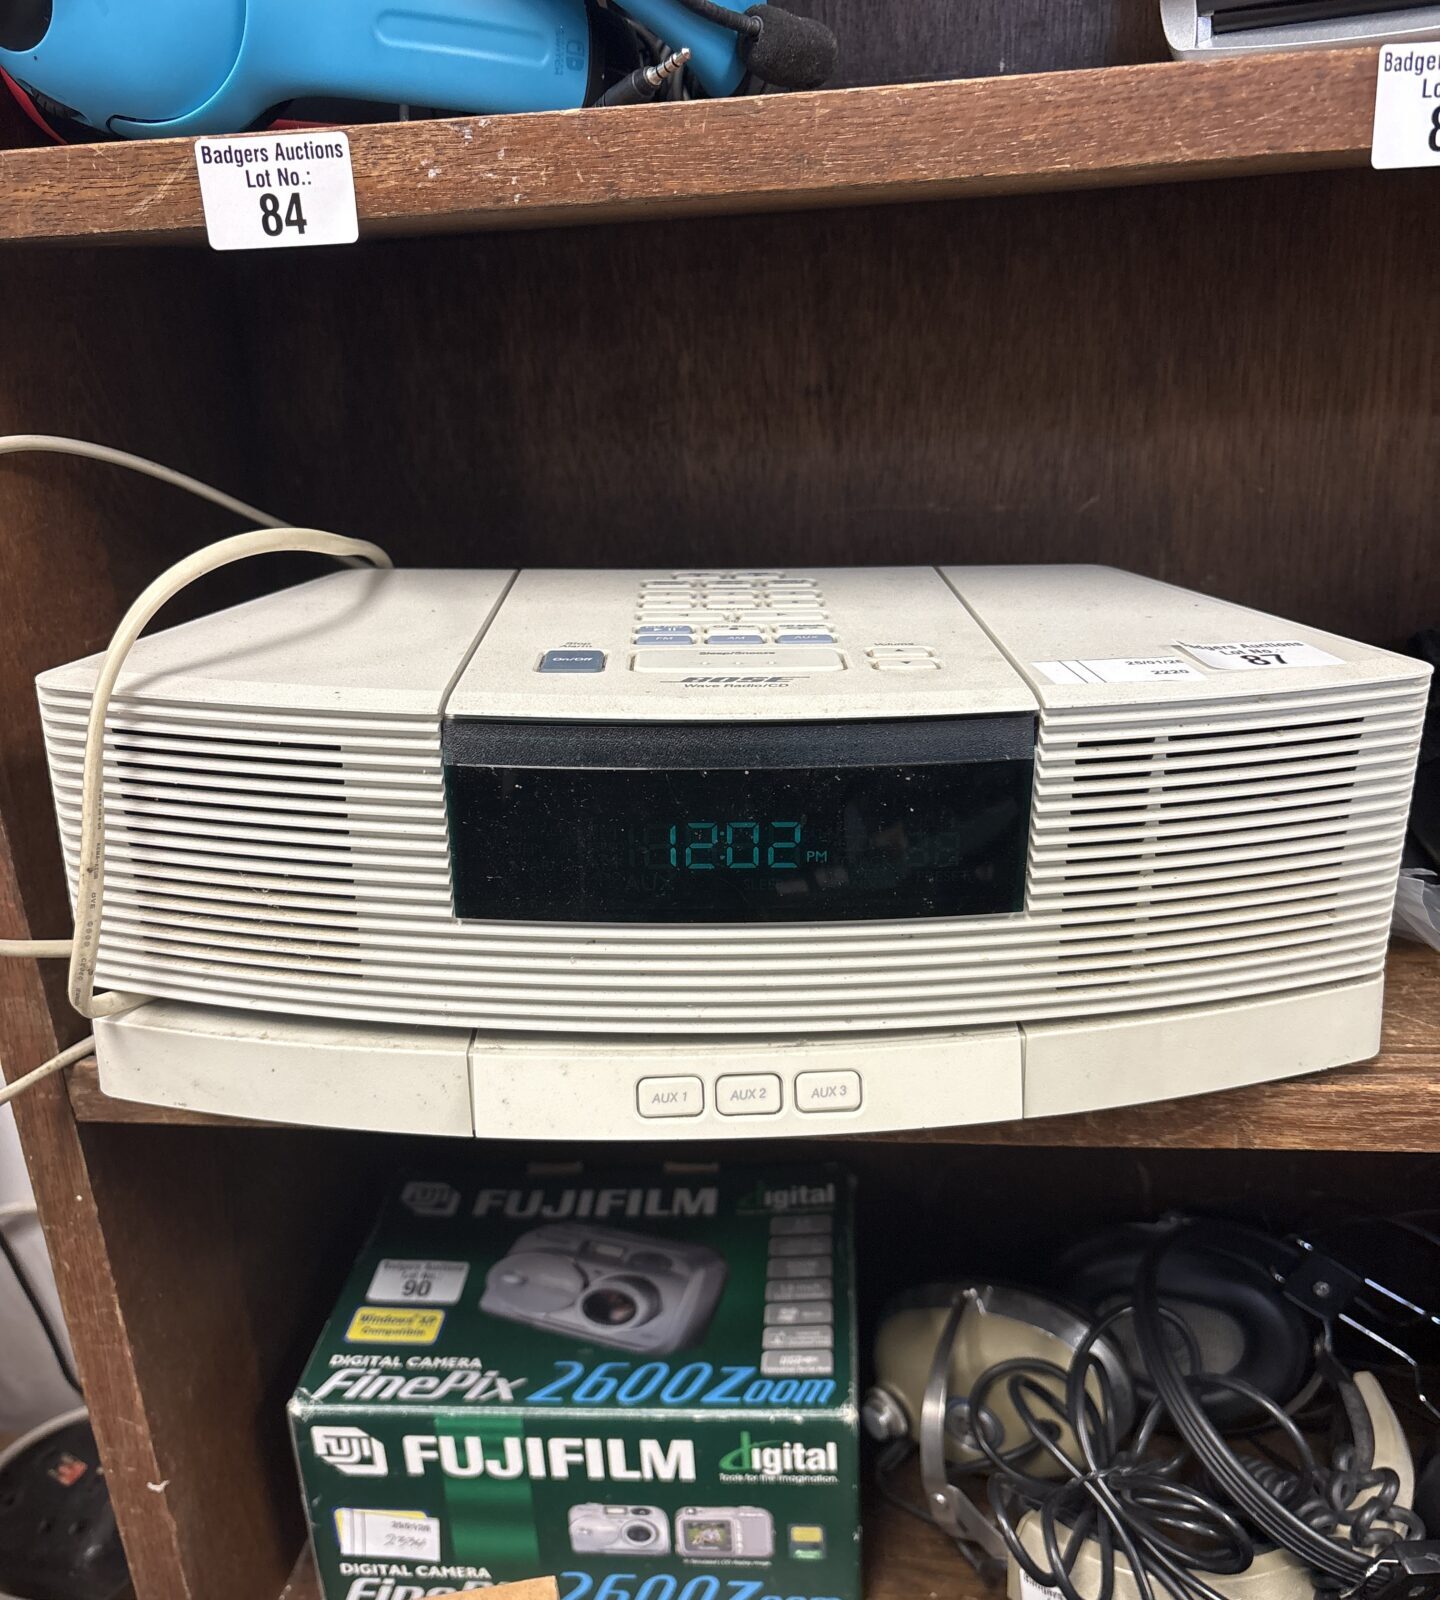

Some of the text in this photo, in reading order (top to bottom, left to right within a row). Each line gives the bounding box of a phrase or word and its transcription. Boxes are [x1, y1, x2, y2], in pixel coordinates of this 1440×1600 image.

[1384, 51, 1440, 76] Badge
[201, 141, 343, 167] Badgers Auctions
[245, 167, 312, 188] Lot No.:
[259, 192, 307, 237] 84
[1240, 653, 1289, 666] 87
[669, 821, 828, 869] 12:02 PM
[651, 1092, 688, 1104] AUX 1
[730, 1088, 767, 1101] AUX 2
[811, 1085, 847, 1099] AUX 3
[471, 1187, 719, 1218] FUJIFILM
[402, 1280, 432, 1297] 90
[329, 1354, 482, 1370] DIGITAL CAMERA
[311, 1367, 528, 1402] FinePix
[402, 1434, 697, 1482] FUJIFILM
[719, 1430, 838, 1475] digital
[339, 1563, 492, 1579] DIGITAL CAMERA
